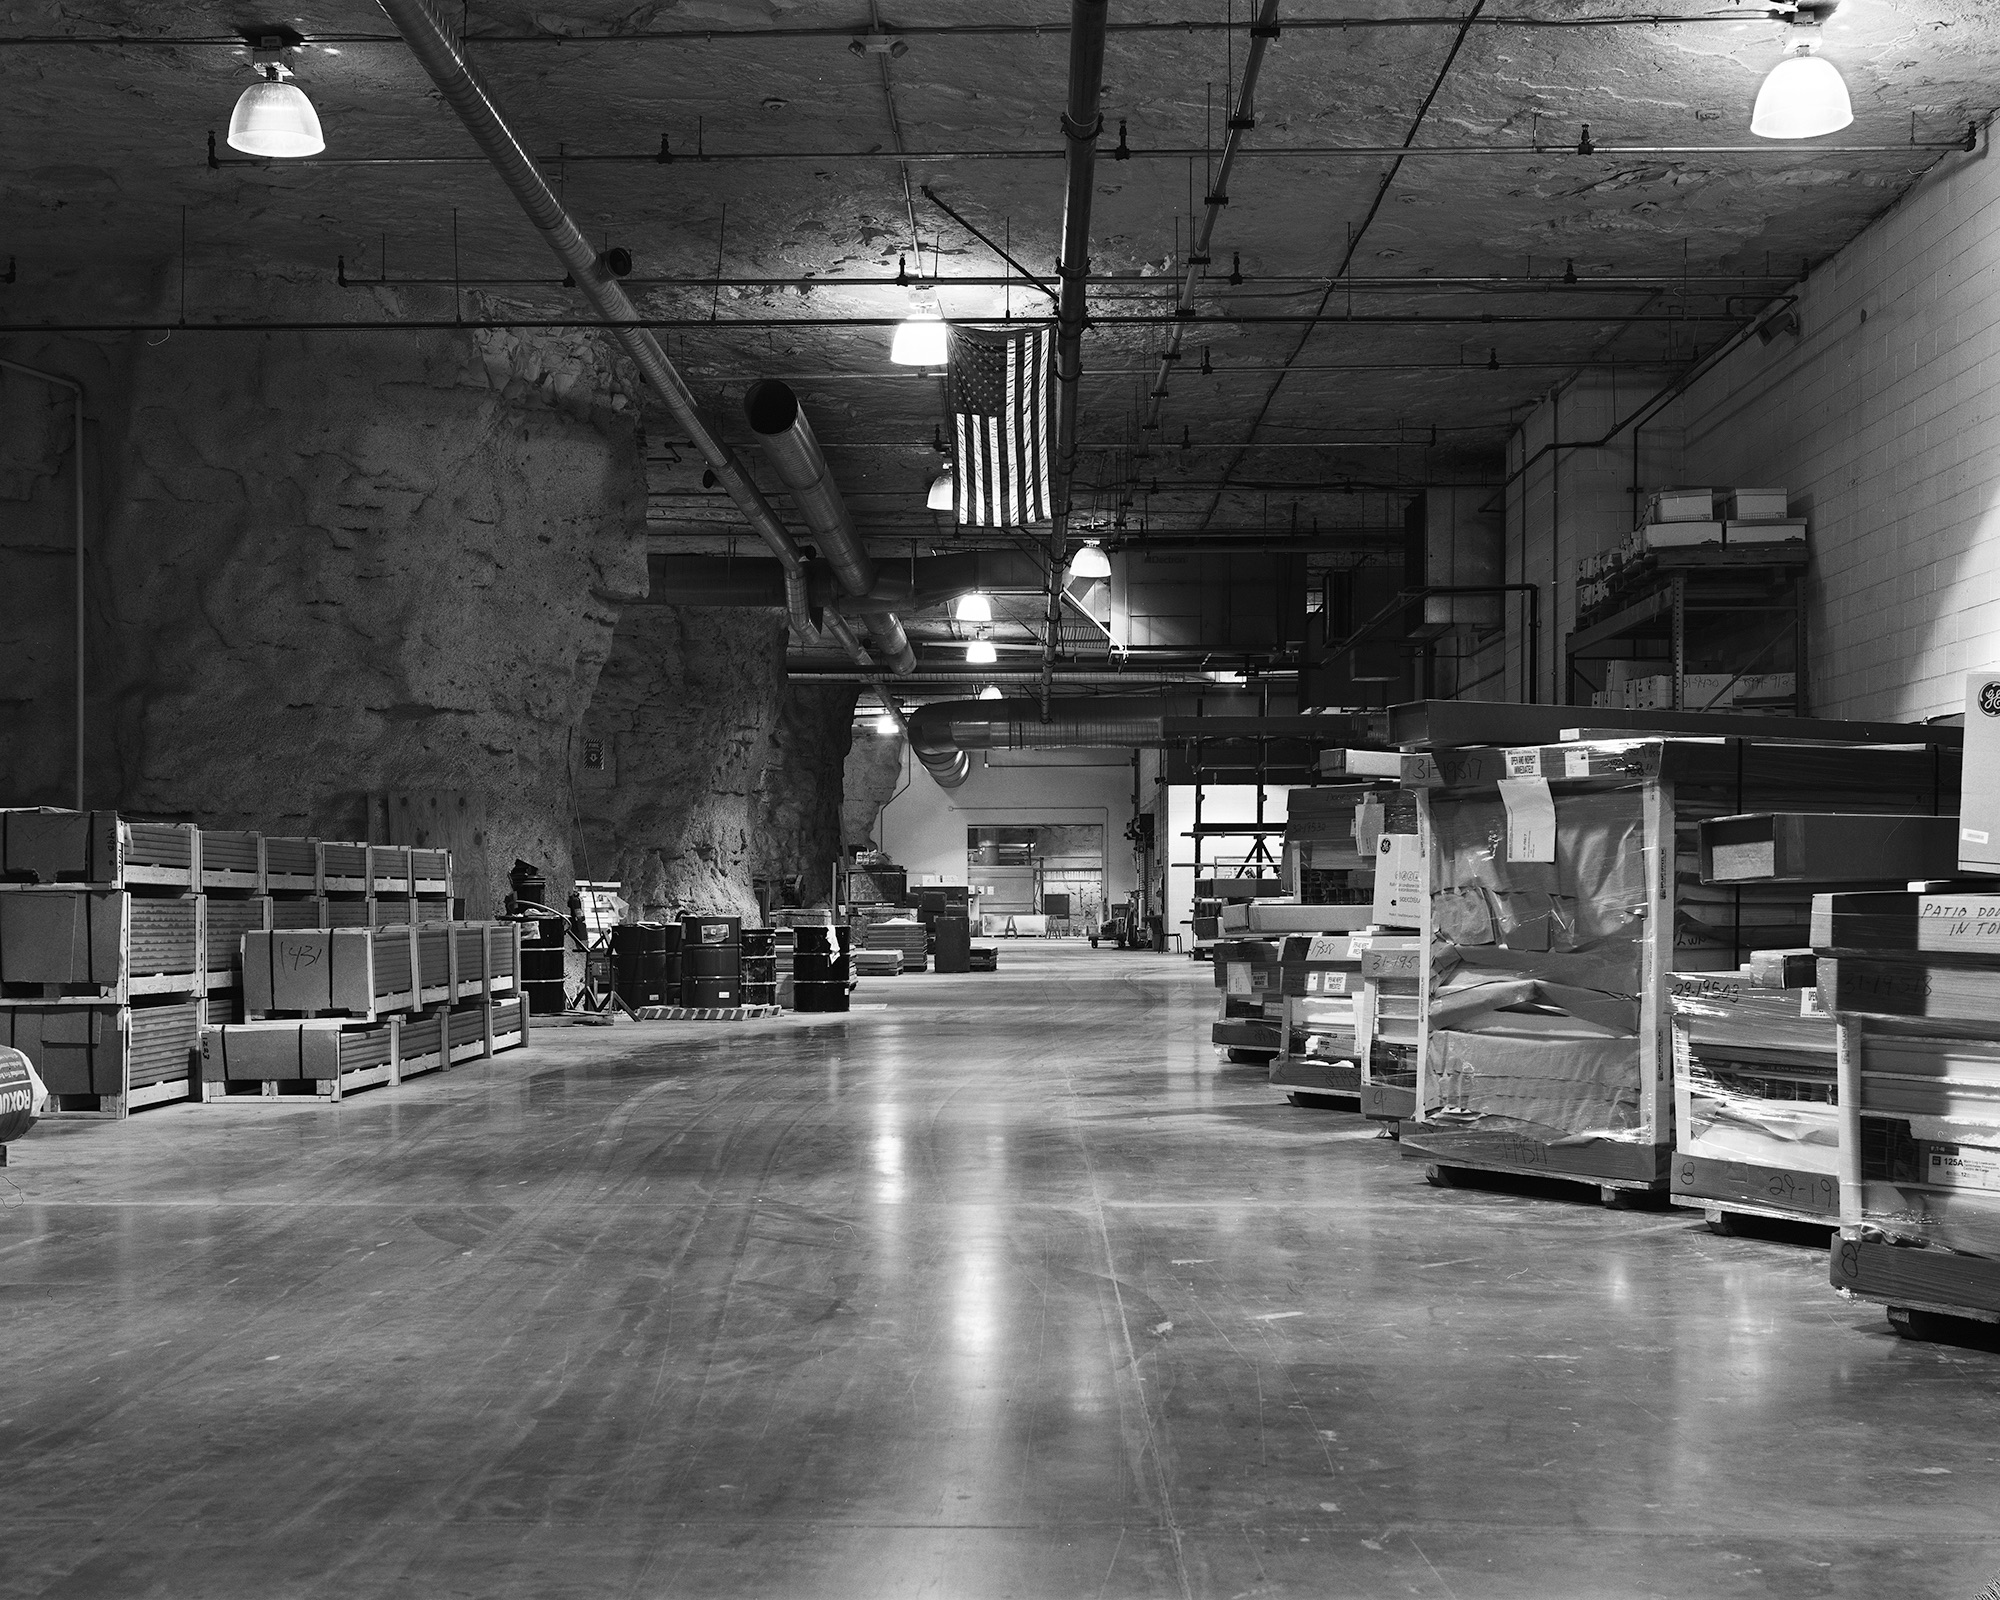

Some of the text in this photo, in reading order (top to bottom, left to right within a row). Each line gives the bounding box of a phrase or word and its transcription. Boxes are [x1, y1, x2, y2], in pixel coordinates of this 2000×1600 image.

[1921, 903, 1967, 919] PATIO
[1949, 922, 1970, 936] IN
[1372, 954, 1420, 971] 31-195
[1944, 1157, 1964, 1167] 125A
[1769, 1174, 1839, 1208] 29-19
